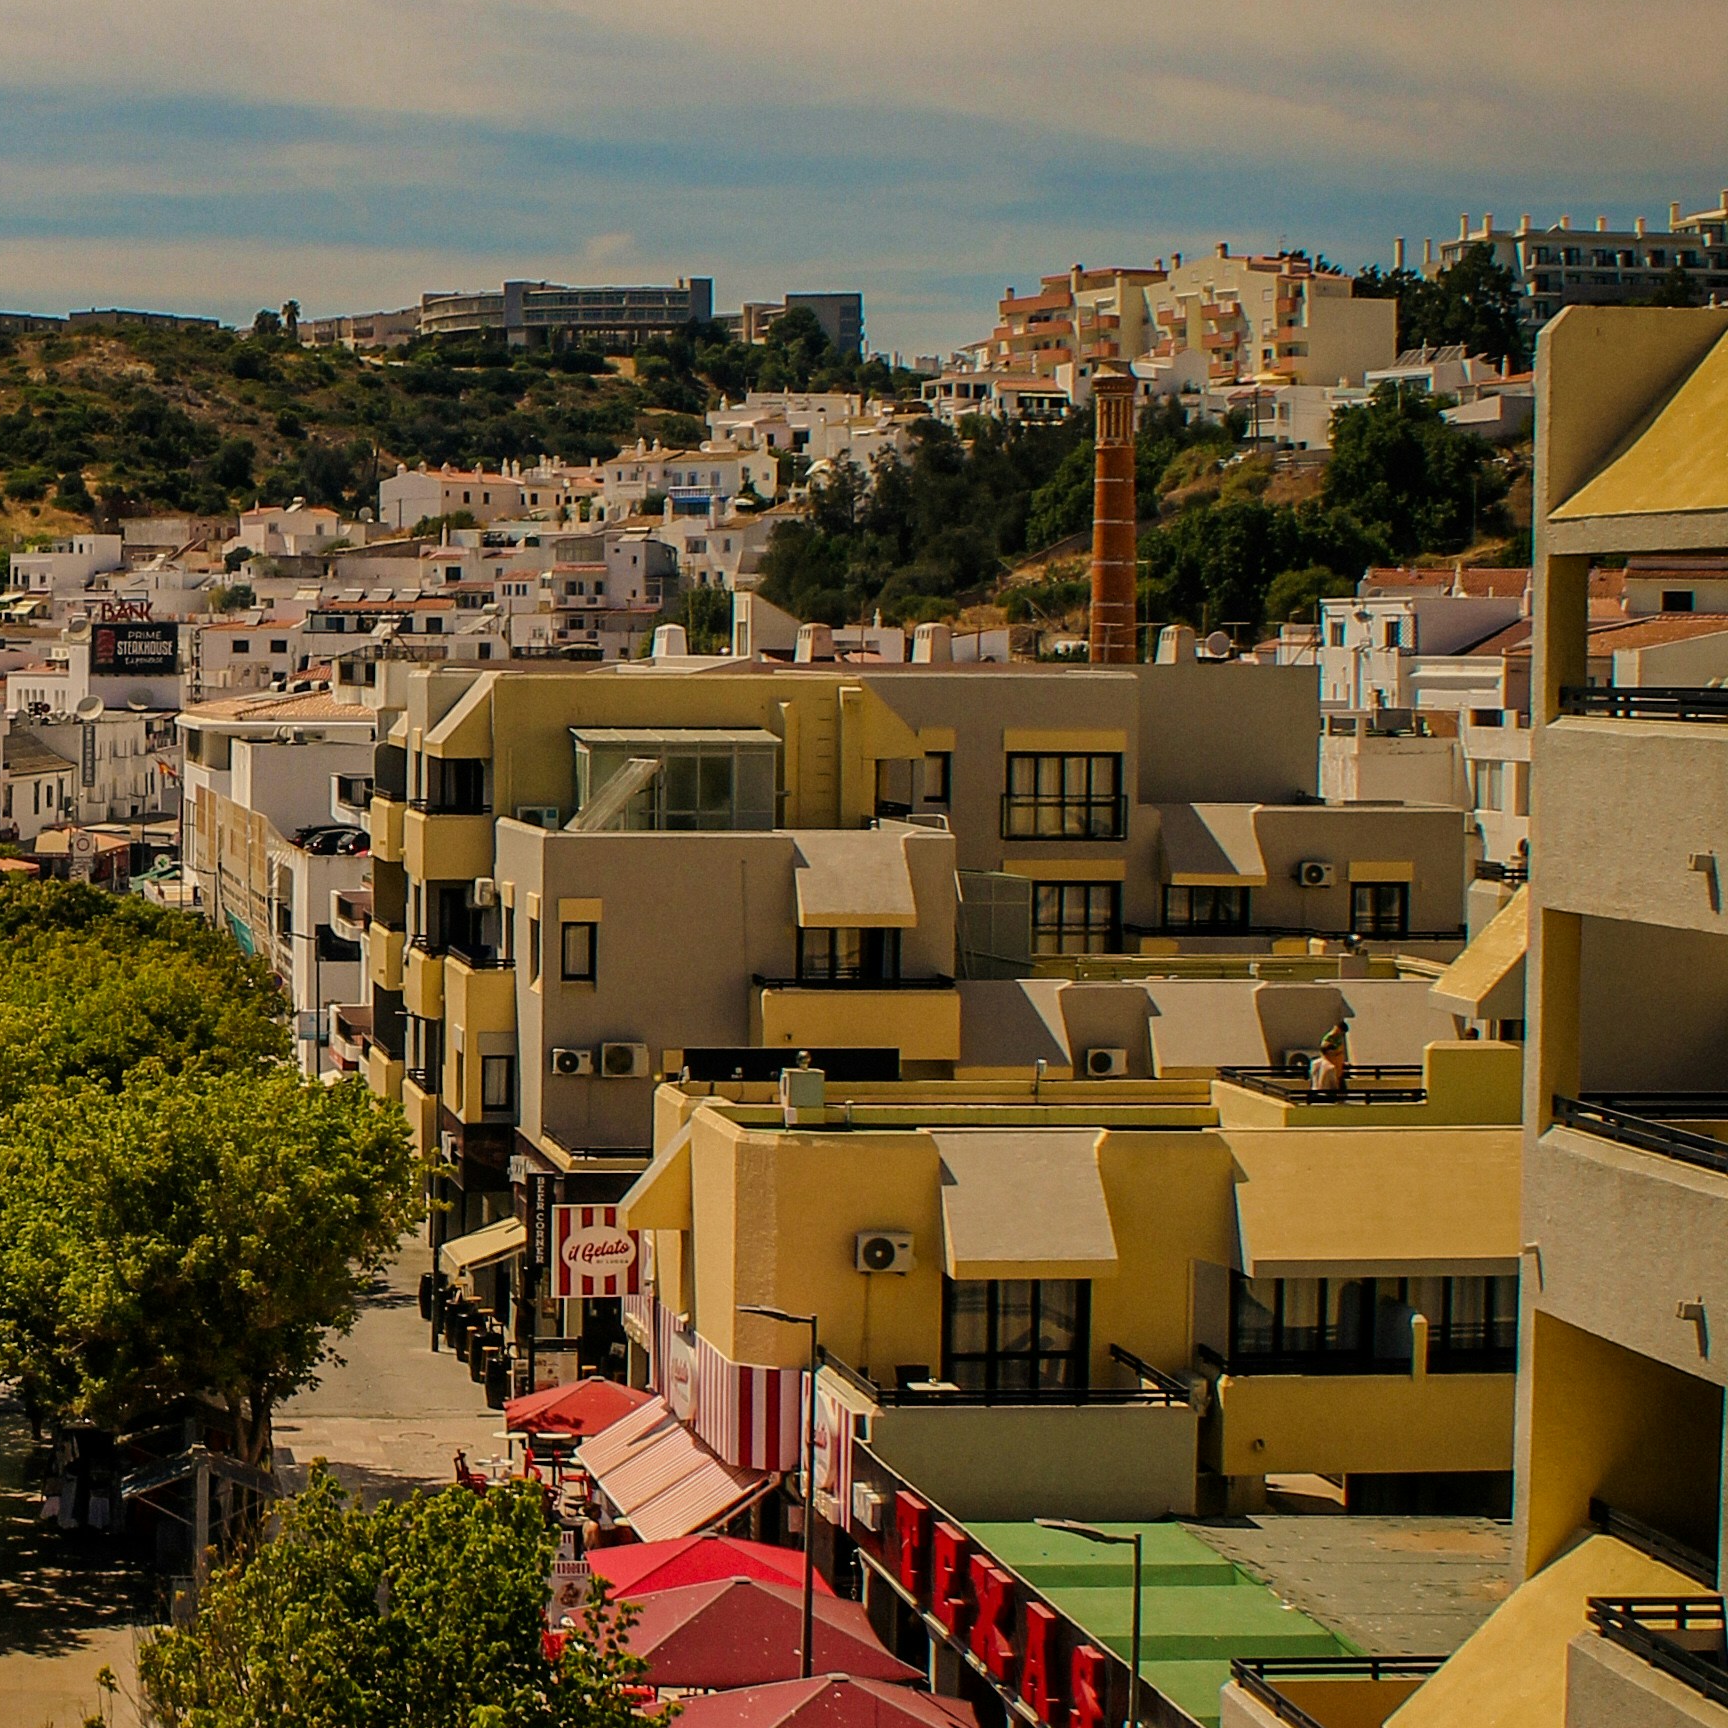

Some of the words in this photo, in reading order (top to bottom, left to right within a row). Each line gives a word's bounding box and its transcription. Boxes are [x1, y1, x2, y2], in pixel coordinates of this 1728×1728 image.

[116, 640, 174, 656] STEAKHOUSE
[128, 631, 163, 640] PRIME
[535, 1177, 545, 1210] BEER
[535, 1212, 545, 1265] CORNER
[568, 1245, 580, 1262] il
[582, 1238, 630, 1264] Gelato
